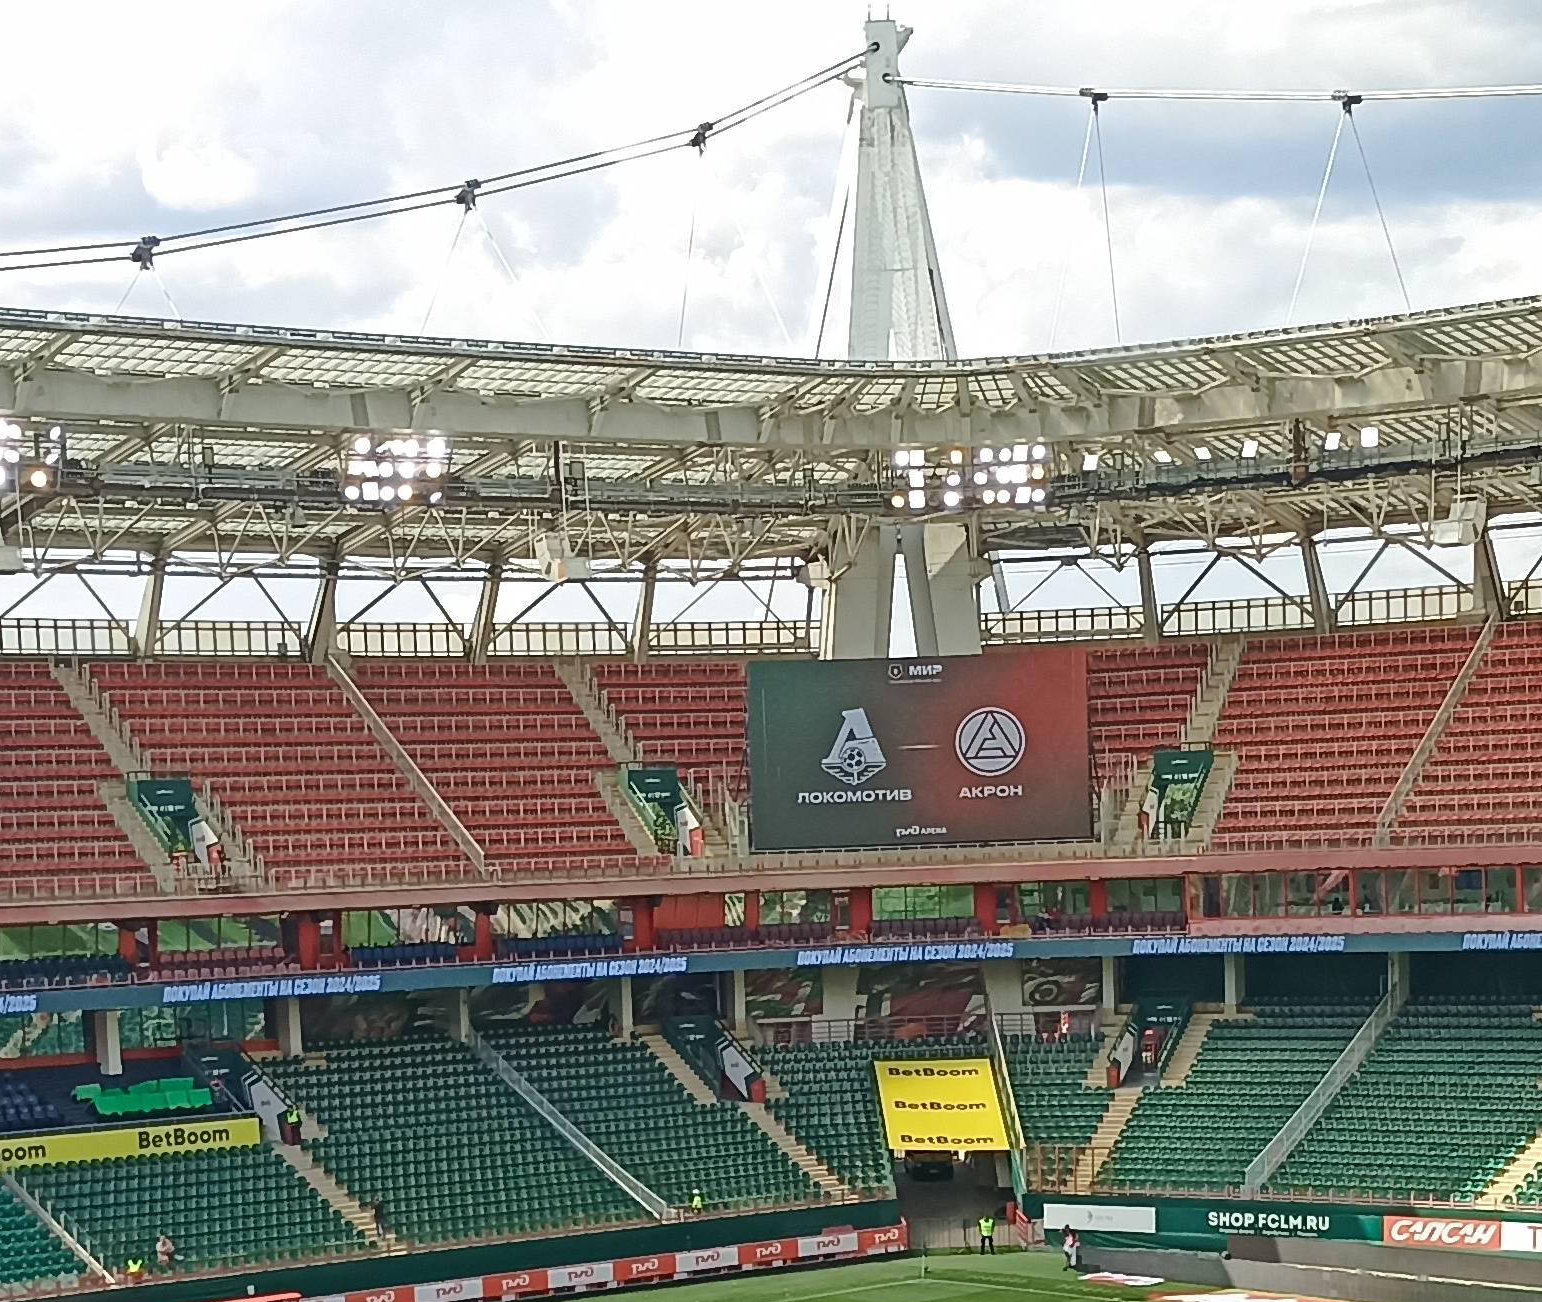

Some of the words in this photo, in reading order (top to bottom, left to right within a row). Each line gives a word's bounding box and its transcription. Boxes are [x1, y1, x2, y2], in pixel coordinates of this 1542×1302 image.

[908, 664, 943, 676] МИР
[797, 789, 912, 804] ЛОКОМОТИВ
[958, 784, 1023, 799] АКРОН
[888, 1067, 979, 1077] BetBoom
[894, 1100, 987, 1111] BetBoom
[137, 1125, 231, 1151] BetBoom
[900, 1134, 994, 1145] BetBoom
[1208, 1211, 1330, 1231] SHOP.FCLM.RU
